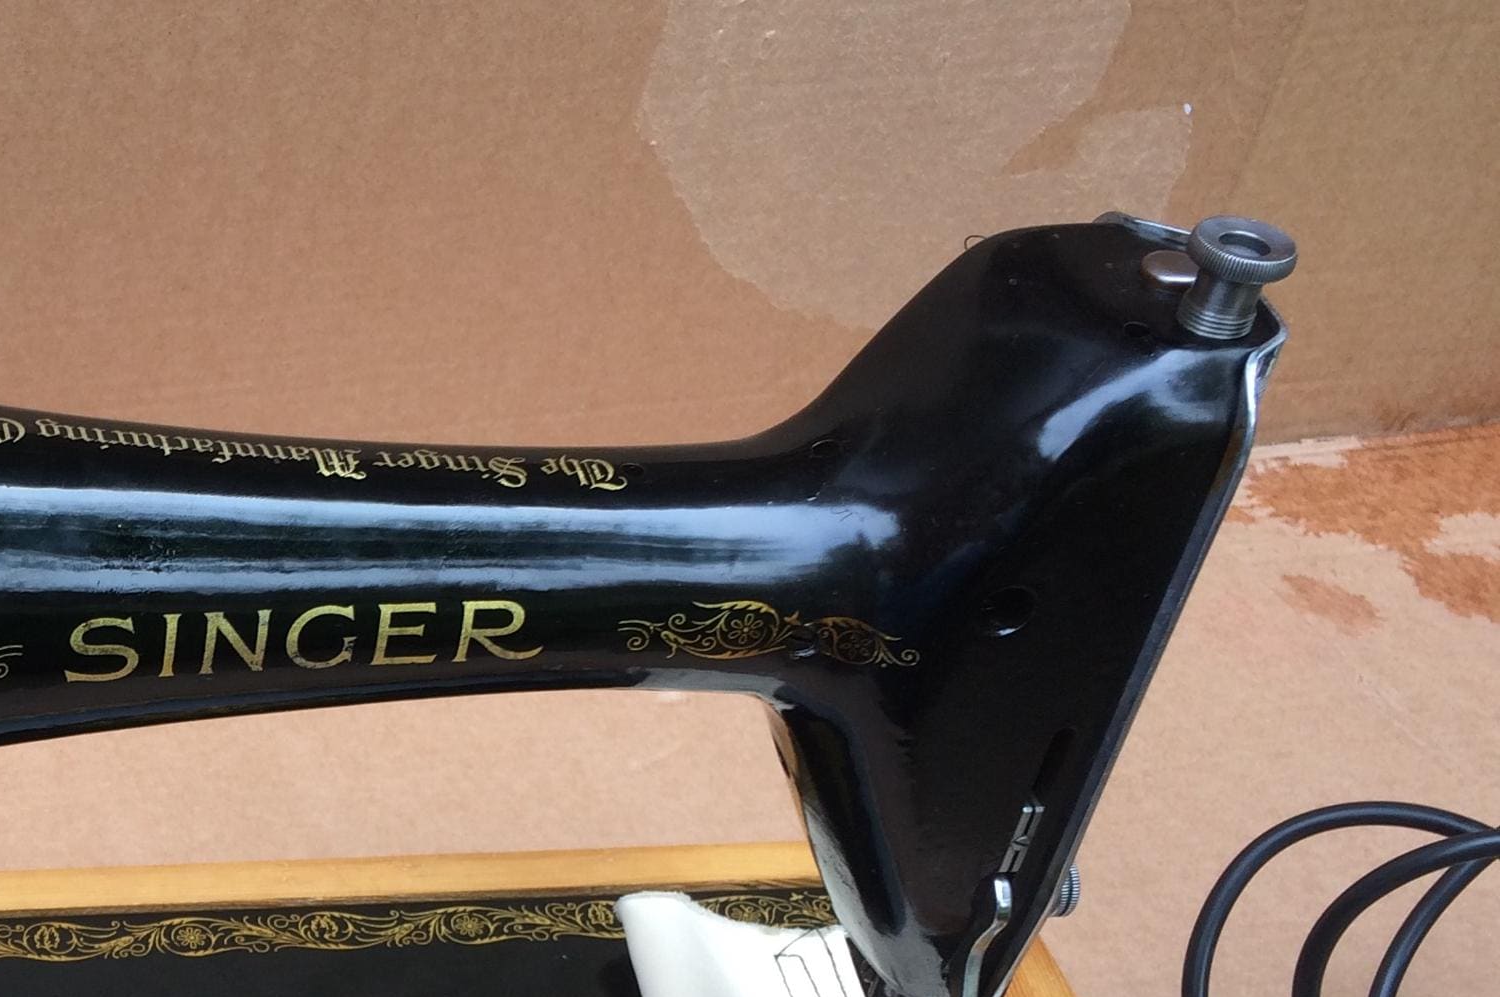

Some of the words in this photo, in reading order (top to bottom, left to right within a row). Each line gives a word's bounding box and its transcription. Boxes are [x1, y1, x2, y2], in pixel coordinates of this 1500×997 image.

[35, 418, 368, 480] Manufacturing
[372, 449, 528, 488] Singer
[540, 454, 628, 491] The
[63, 600, 545, 683] SINGER
